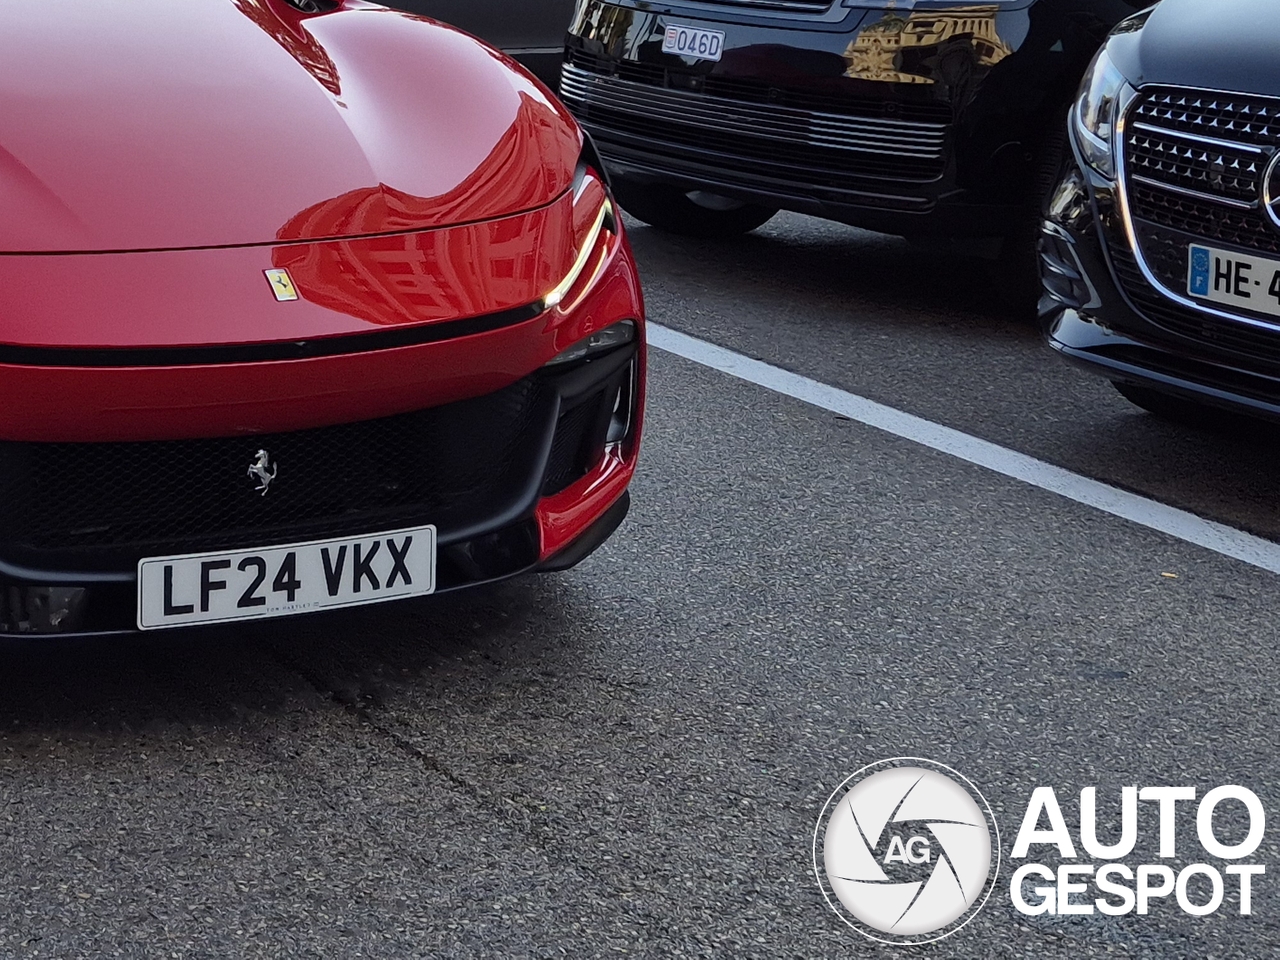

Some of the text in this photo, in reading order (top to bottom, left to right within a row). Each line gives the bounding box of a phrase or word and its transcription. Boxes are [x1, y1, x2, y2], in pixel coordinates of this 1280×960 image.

[677, 30, 721, 57] 046D
[1195, 276, 1203, 287] F
[163, 535, 414, 617] LF24 VKX
